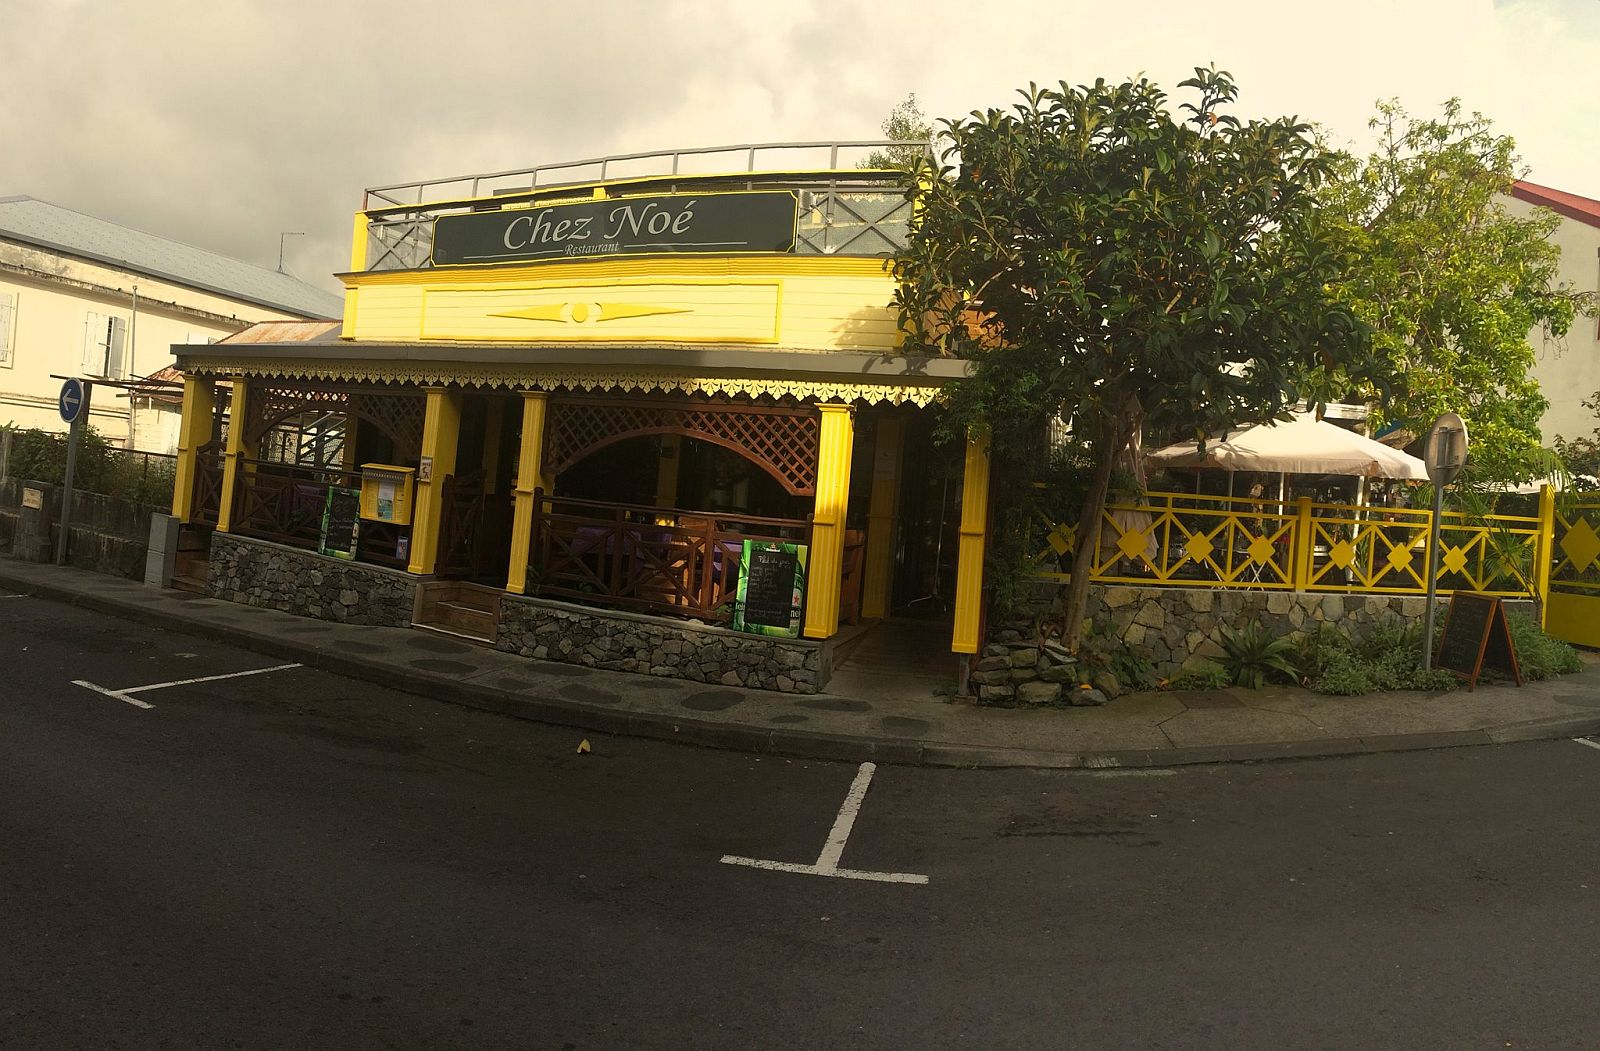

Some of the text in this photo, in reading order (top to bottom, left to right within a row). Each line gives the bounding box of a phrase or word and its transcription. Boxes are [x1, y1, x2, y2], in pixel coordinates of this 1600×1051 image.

[503, 200, 697, 250] Chez Noé
[564, 241, 620, 257] Restaurant
